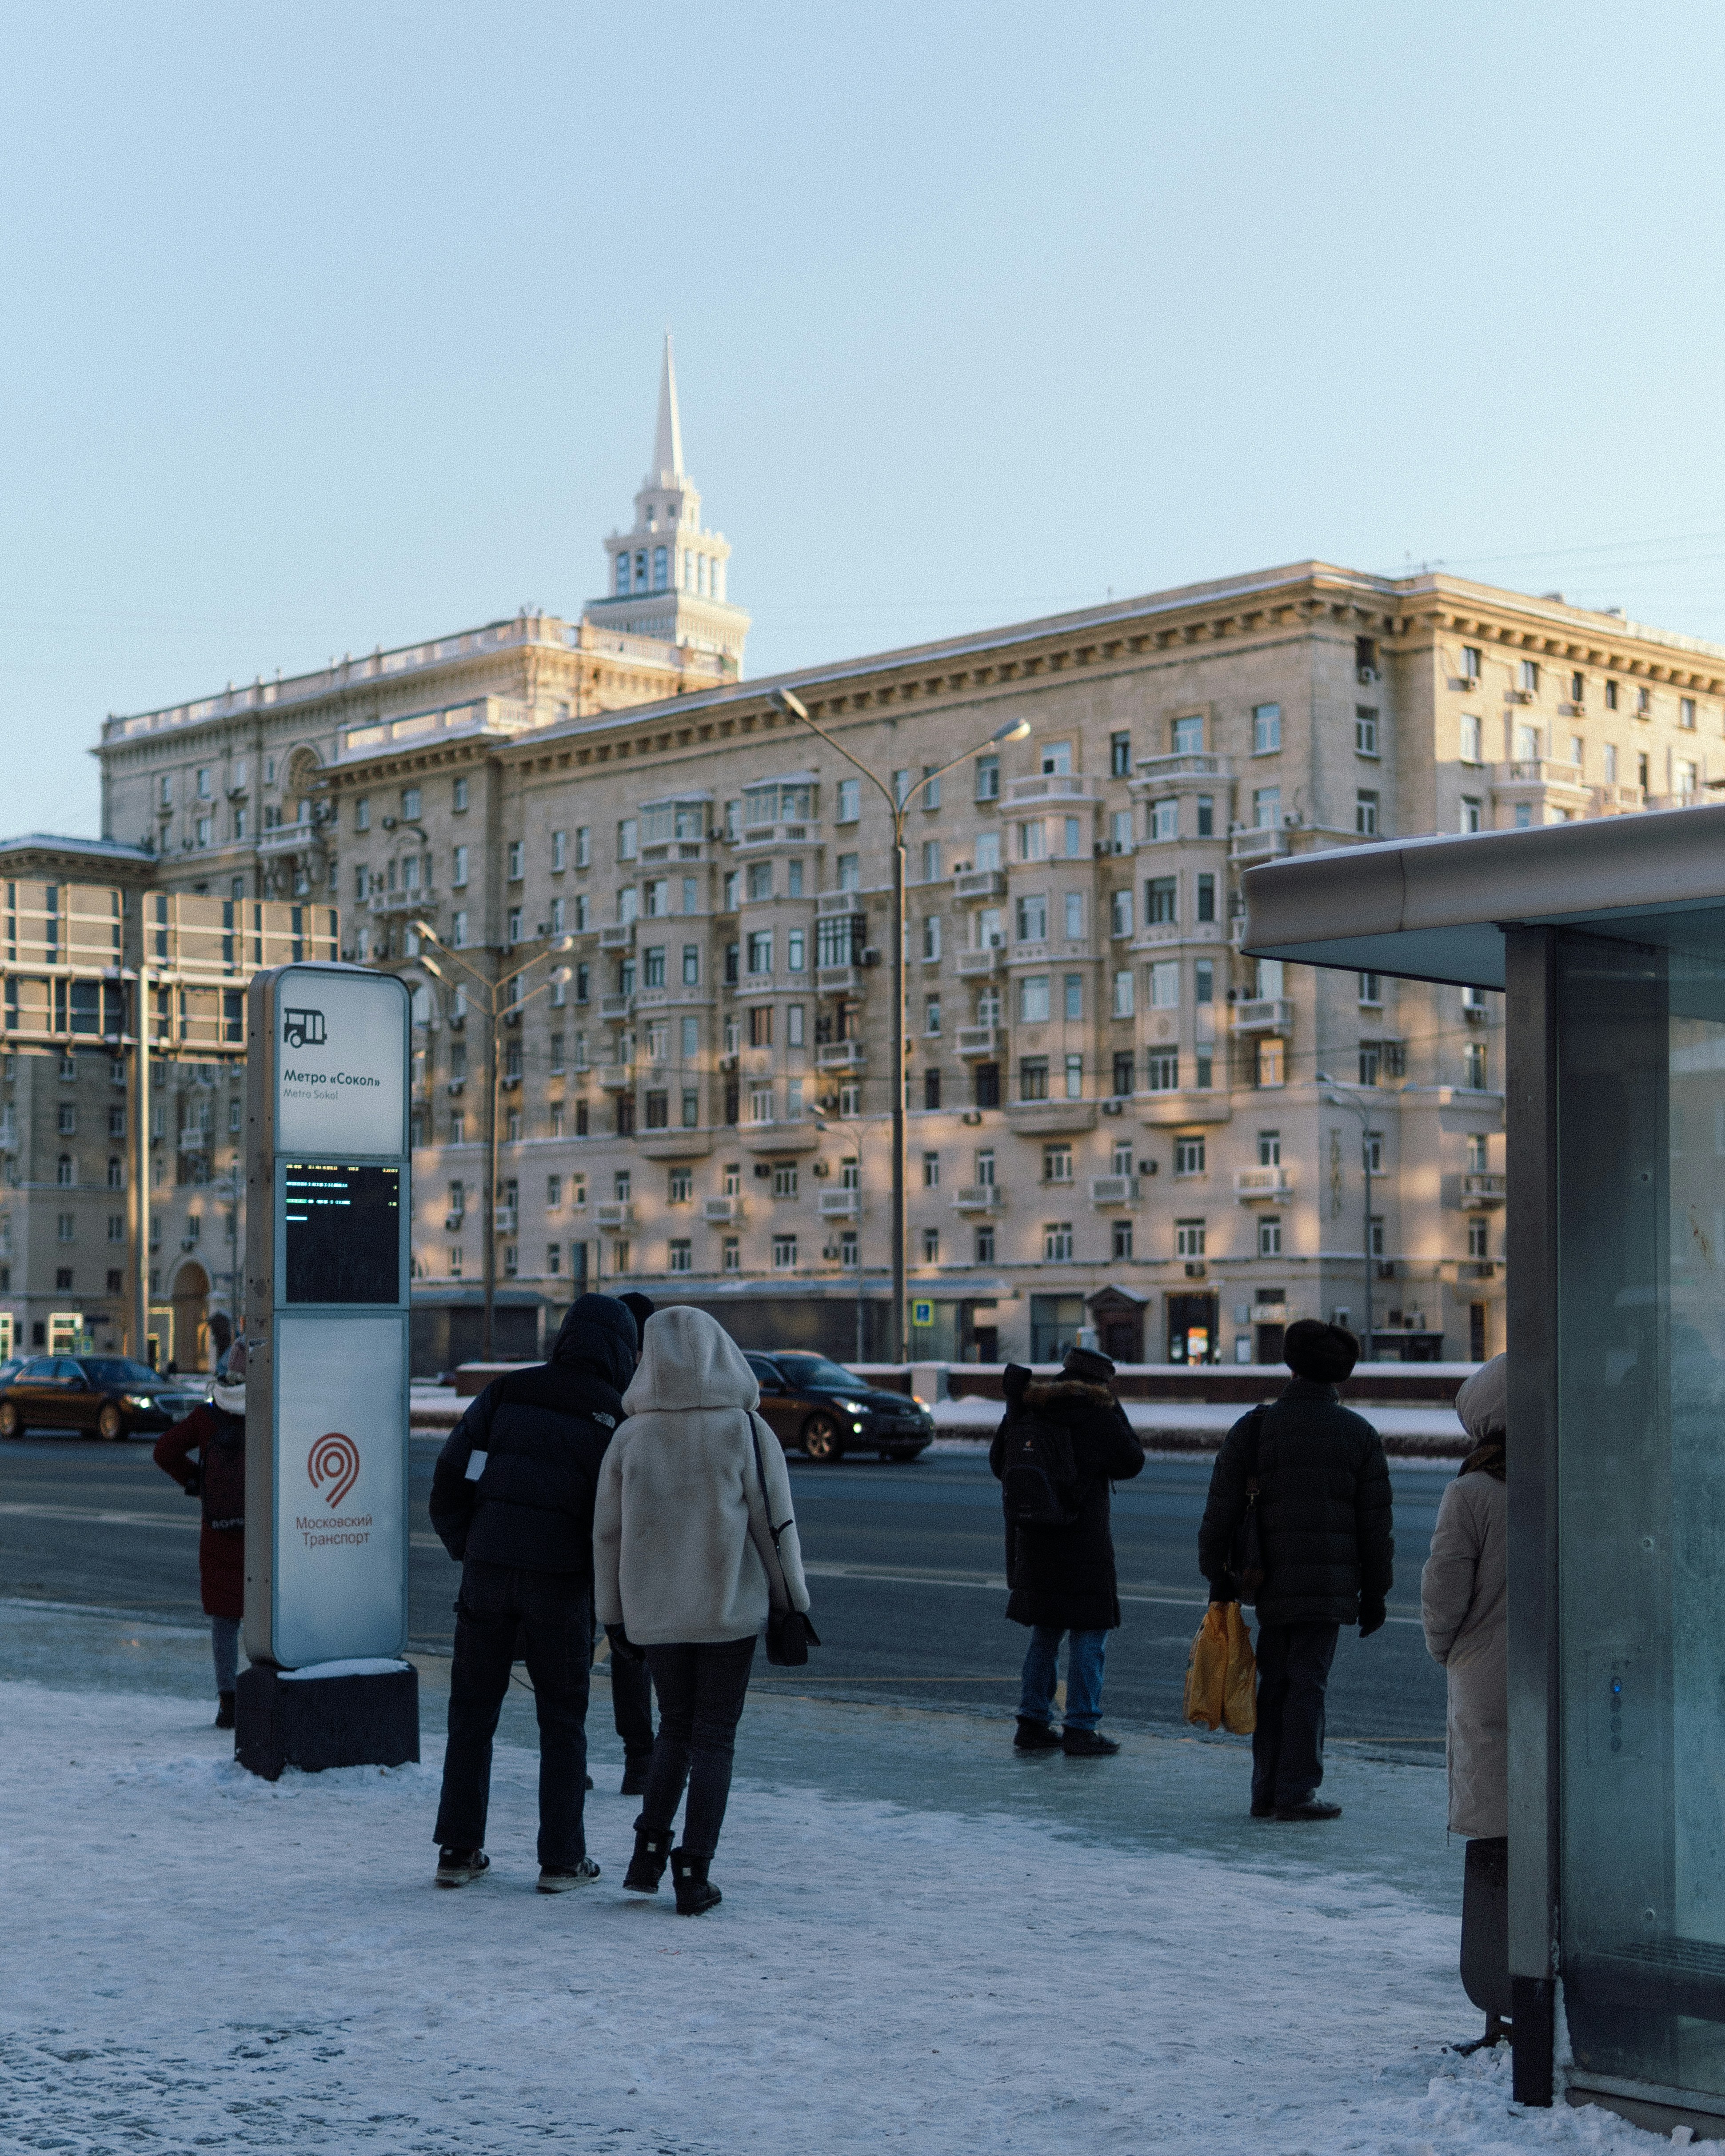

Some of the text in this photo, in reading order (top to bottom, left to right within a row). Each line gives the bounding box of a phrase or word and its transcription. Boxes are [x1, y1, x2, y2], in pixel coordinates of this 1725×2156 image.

[284, 1069, 380, 1086] Метро «Сокол»
[283, 1089, 338, 1100] Metro Sokol
[296, 1513, 372, 1529] Московский
[303, 1532, 370, 1548] Транспорт
